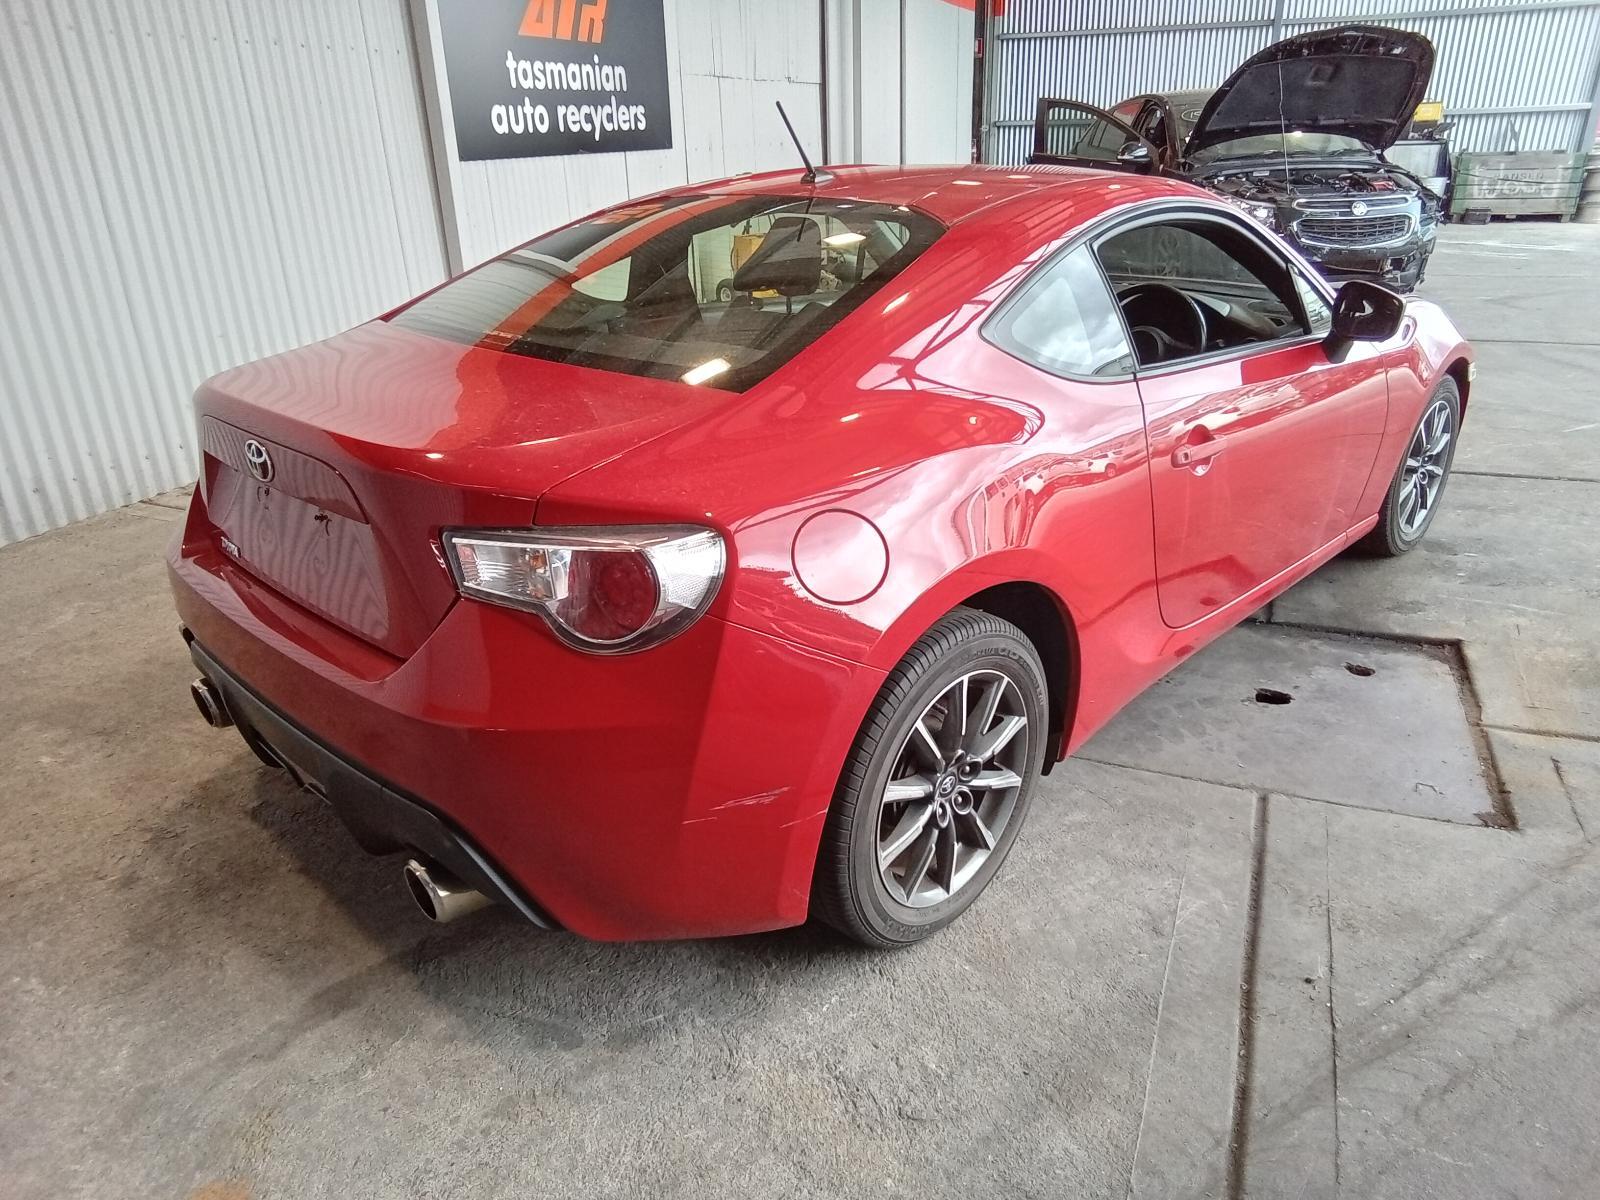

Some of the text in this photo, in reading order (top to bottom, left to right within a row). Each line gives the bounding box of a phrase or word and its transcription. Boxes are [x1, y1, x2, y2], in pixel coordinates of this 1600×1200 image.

[505, 49, 627, 92] tasmanian
[491, 95, 647, 142] auto recyclers
